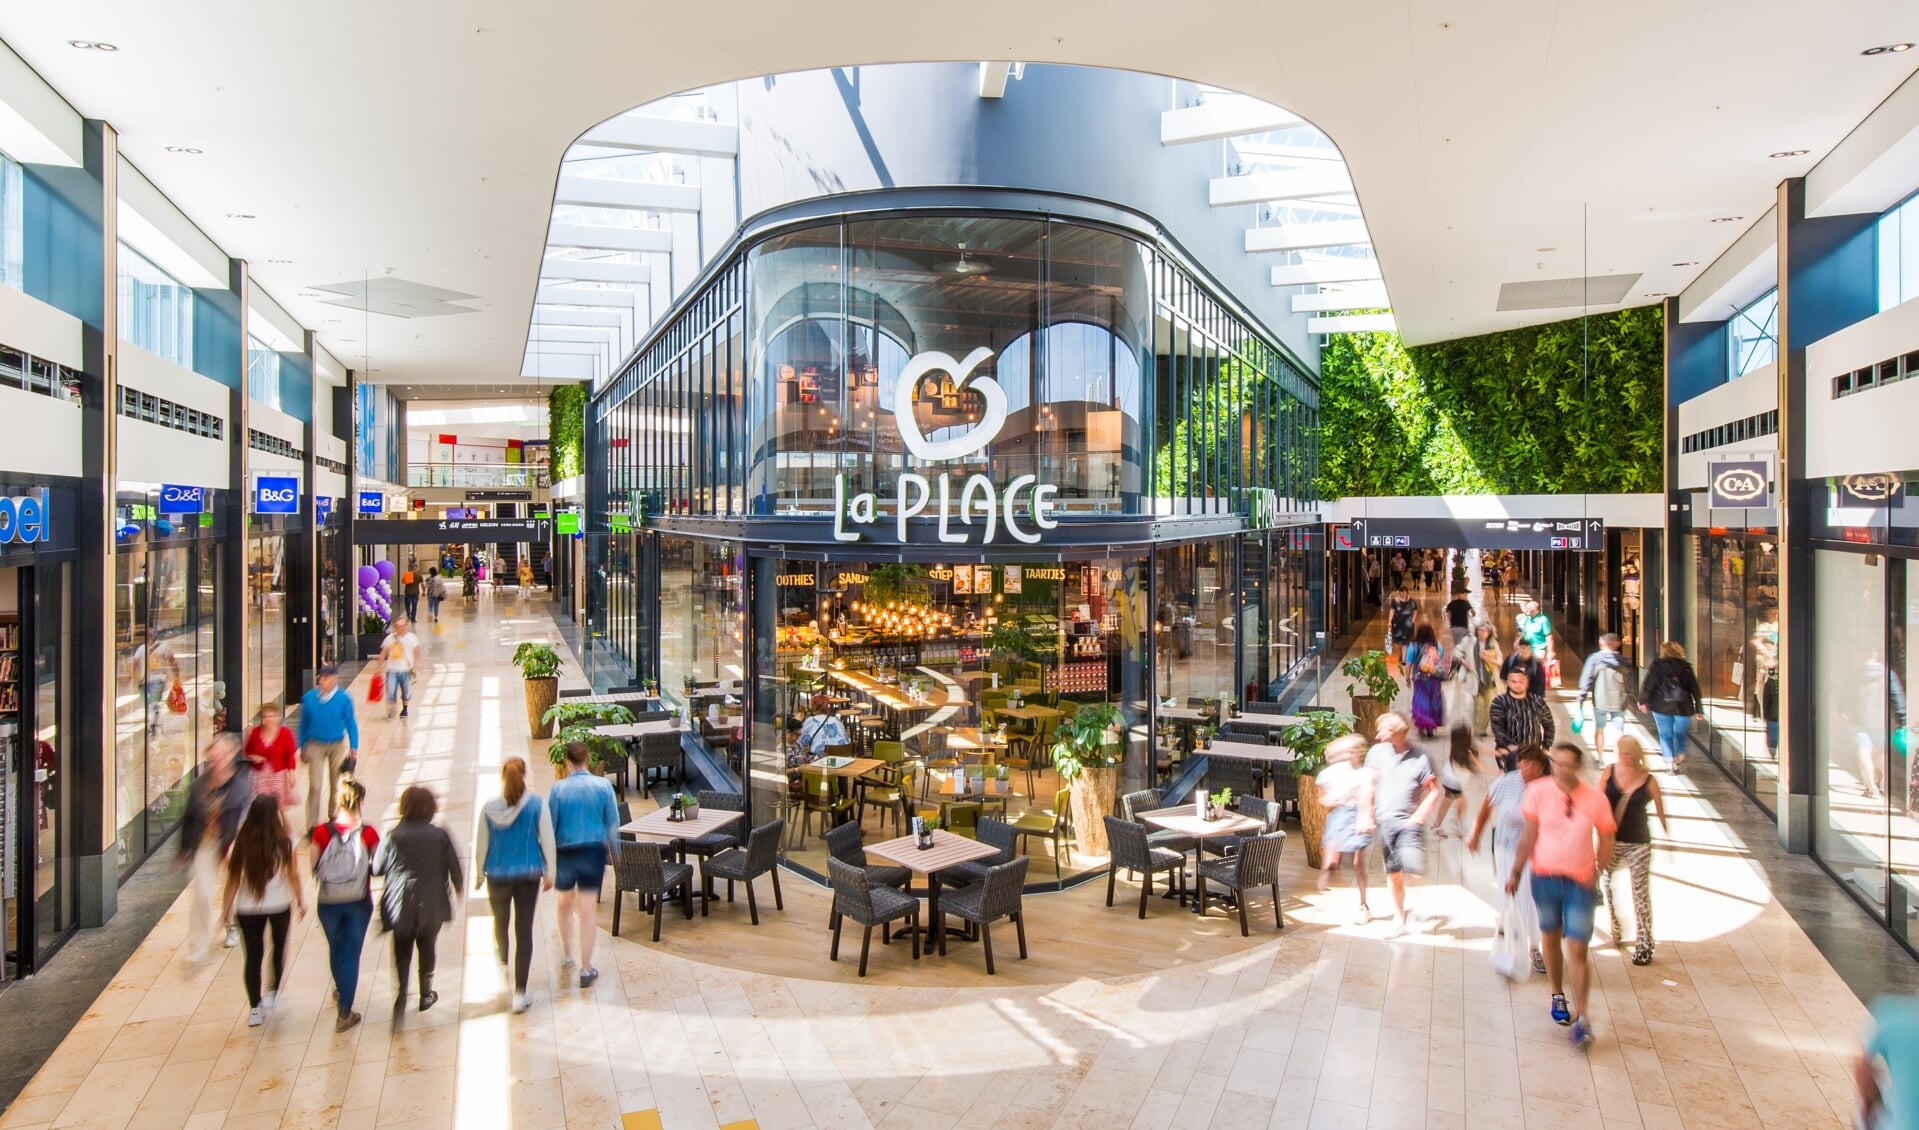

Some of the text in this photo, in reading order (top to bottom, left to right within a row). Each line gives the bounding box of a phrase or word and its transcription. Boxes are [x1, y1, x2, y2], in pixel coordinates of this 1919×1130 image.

[1723, 477, 1756, 491] C&A
[260, 488, 294, 502] B&G
[834, 473, 1058, 544] La PLACE
[775, 574, 815, 586] OOTHIES
[1025, 568, 1066, 580] TAARTJES
